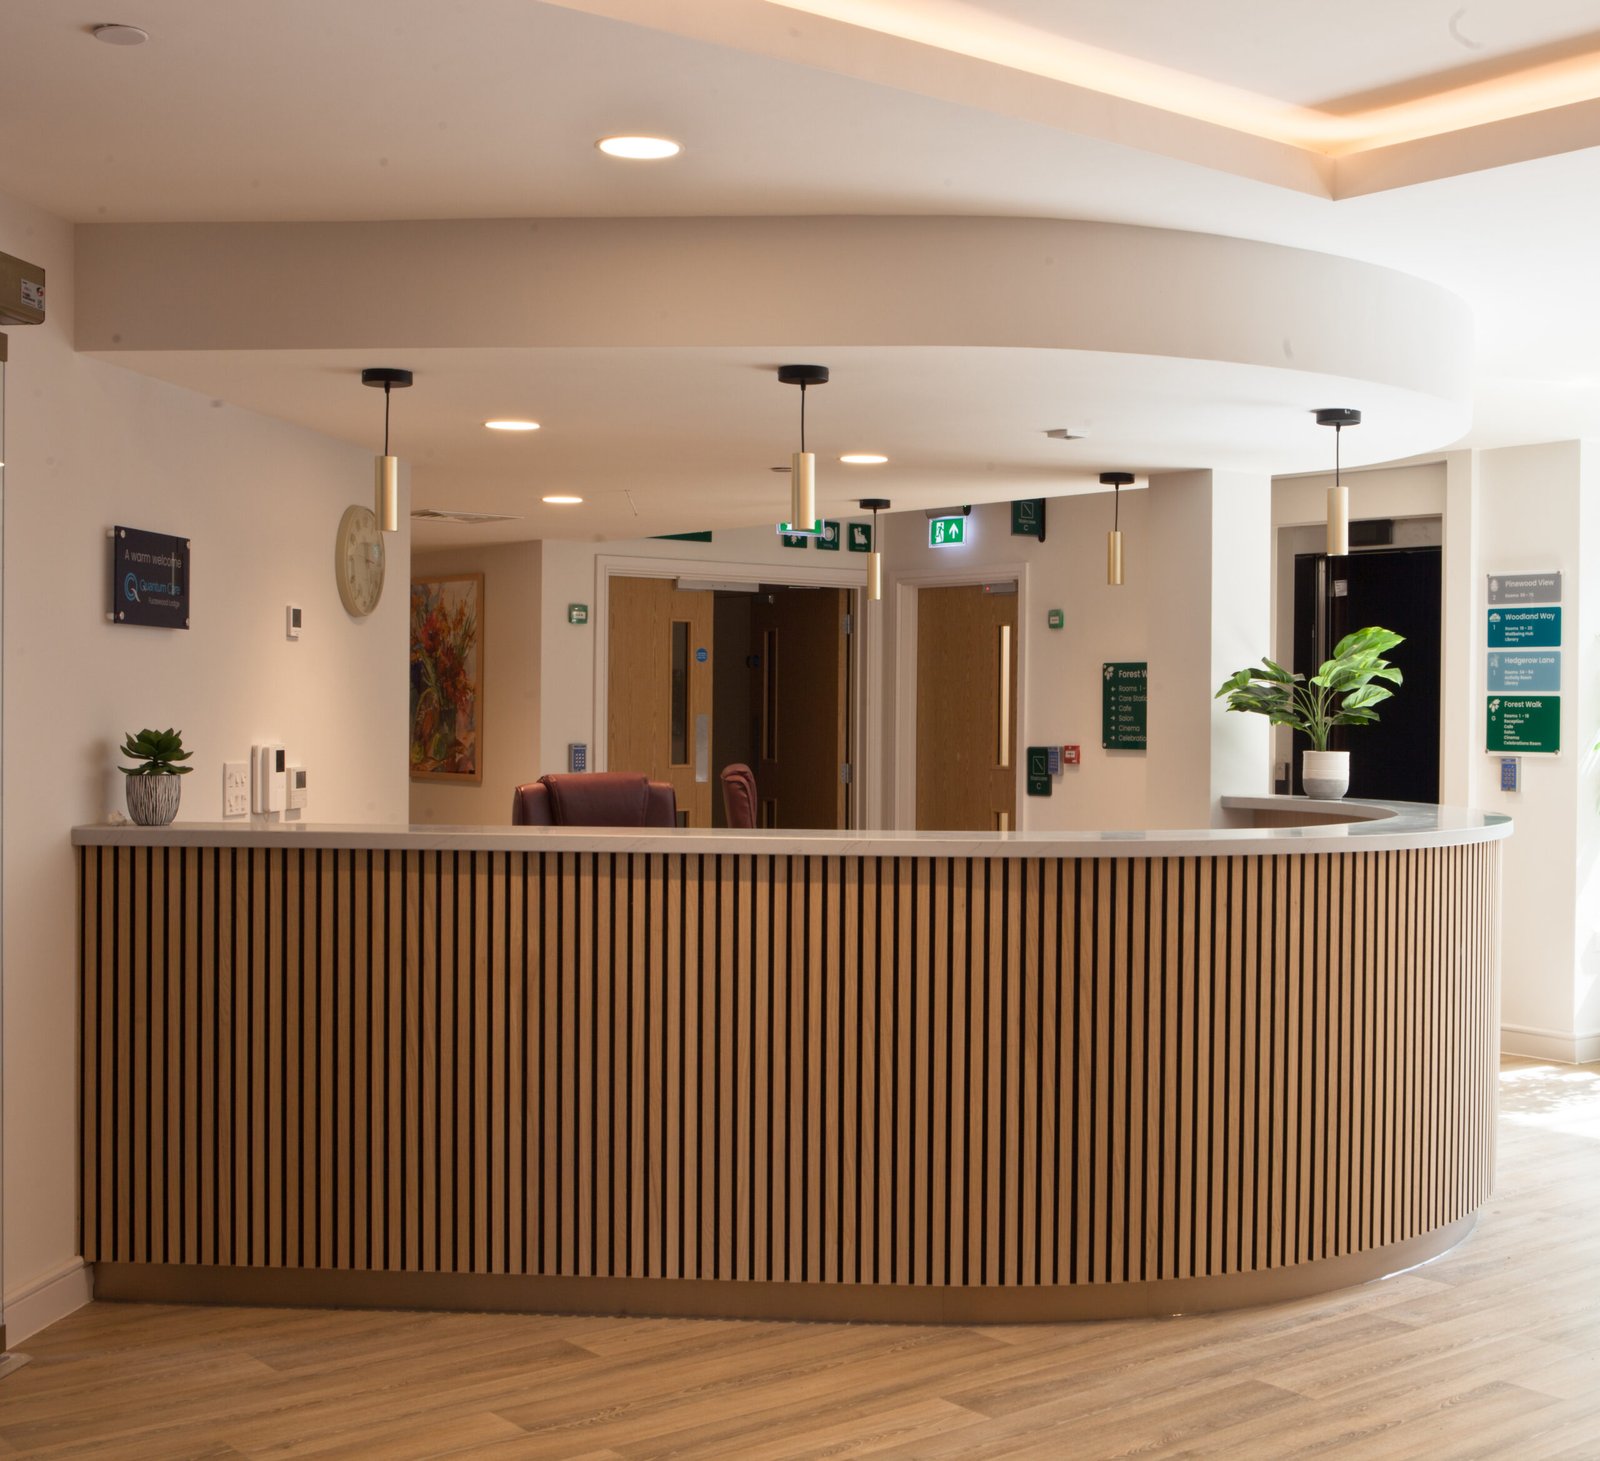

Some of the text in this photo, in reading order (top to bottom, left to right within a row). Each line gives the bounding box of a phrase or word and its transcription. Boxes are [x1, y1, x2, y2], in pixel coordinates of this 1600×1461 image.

[124, 549, 182, 568] A warm welcome
[140, 579, 180, 596] Quantum Care
[1505, 579, 1537, 588] Pinewood
[1504, 657, 1538, 665] Hedgerow
[1118, 670, 1140, 678] Forest
